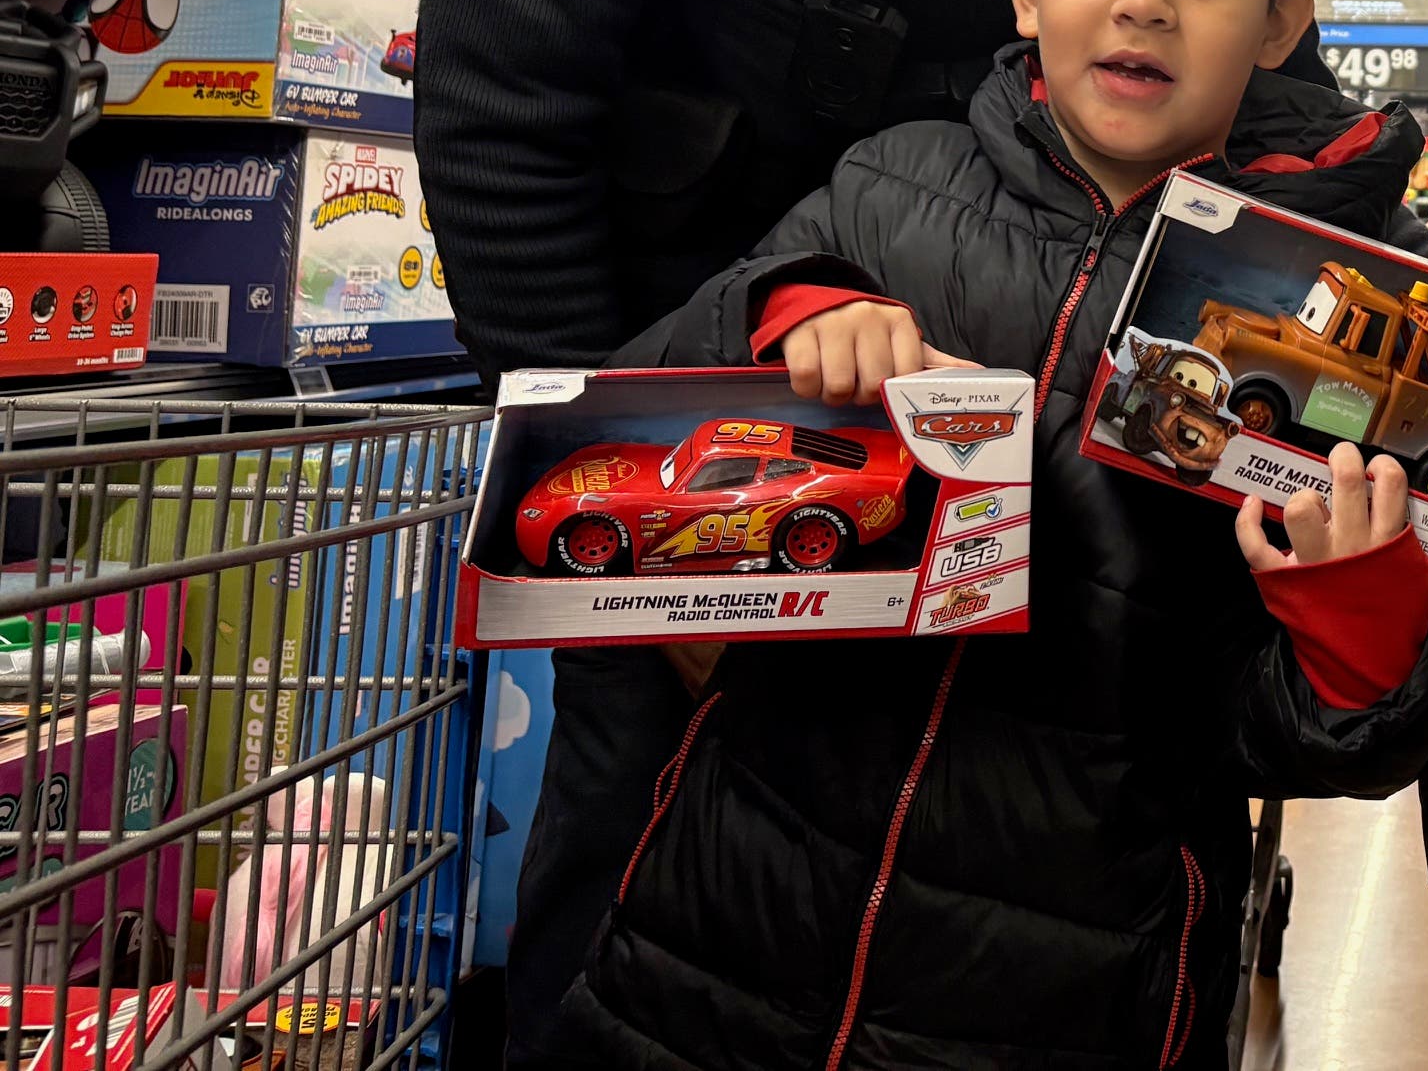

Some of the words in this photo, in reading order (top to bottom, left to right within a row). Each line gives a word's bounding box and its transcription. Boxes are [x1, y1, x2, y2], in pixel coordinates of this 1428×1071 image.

[291, 49, 338, 74] ImaginAir
[301, 86, 338, 104] BUMPER
[340, 91, 358, 107] CAR
[135, 157, 281, 203] ImaginAir
[323, 163, 403, 202] SPIDEY
[156, 207, 253, 222] RIDEALONGS
[314, 192, 365, 229] AMAZING
[366, 191, 405, 218] FRIENDS
[314, 325, 350, 343] BUMPER
[351, 325, 369, 340] CAR
[928, 392, 962, 407] Disney
[968, 394, 1001, 403] PIXAR
[1316, 381, 1340, 393] TOW
[1343, 380, 1373, 408] MATER
[711, 422, 783, 444] 95
[921, 415, 1004, 434] Cars
[1235, 466, 1273, 487] RADIO
[1247, 454, 1285, 476] TOW
[1285, 469, 1333, 496] MATER
[696, 513, 750, 553] 95
[793, 508, 849, 537] LIGHTYEAR
[558, 536, 605, 575] LIGHTYEAR
[941, 544, 1002, 577] USB
[592, 593, 688, 611] LIGHTNING
[692, 593, 778, 609] McQUEEN
[778, 591, 830, 618] R/C
[667, 609, 710, 622] RADIO
[714, 608, 776, 621] CONTROL
[888, 596, 904, 607] 6+
[930, 594, 991, 627] TURBO
